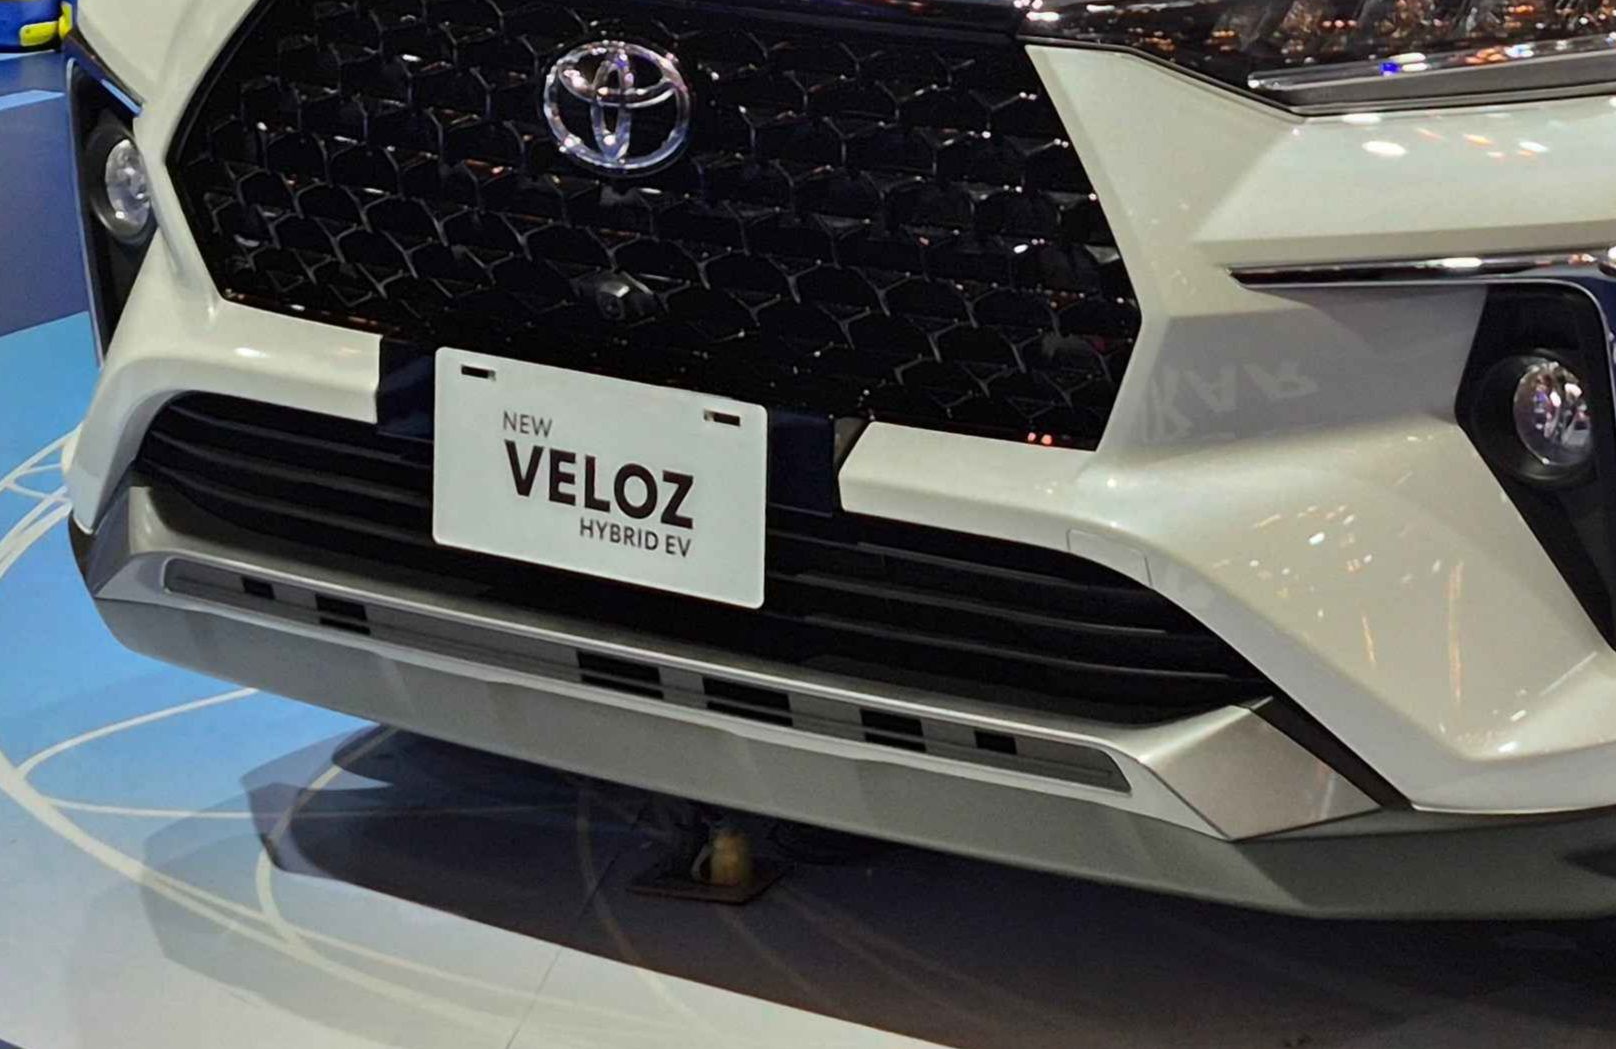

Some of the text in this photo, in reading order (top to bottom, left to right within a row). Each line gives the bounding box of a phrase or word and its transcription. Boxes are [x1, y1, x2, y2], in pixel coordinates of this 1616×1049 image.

[502, 411, 552, 438] NEW
[504, 439, 694, 530] VELOZ
[579, 517, 692, 558] HYBRID EV
